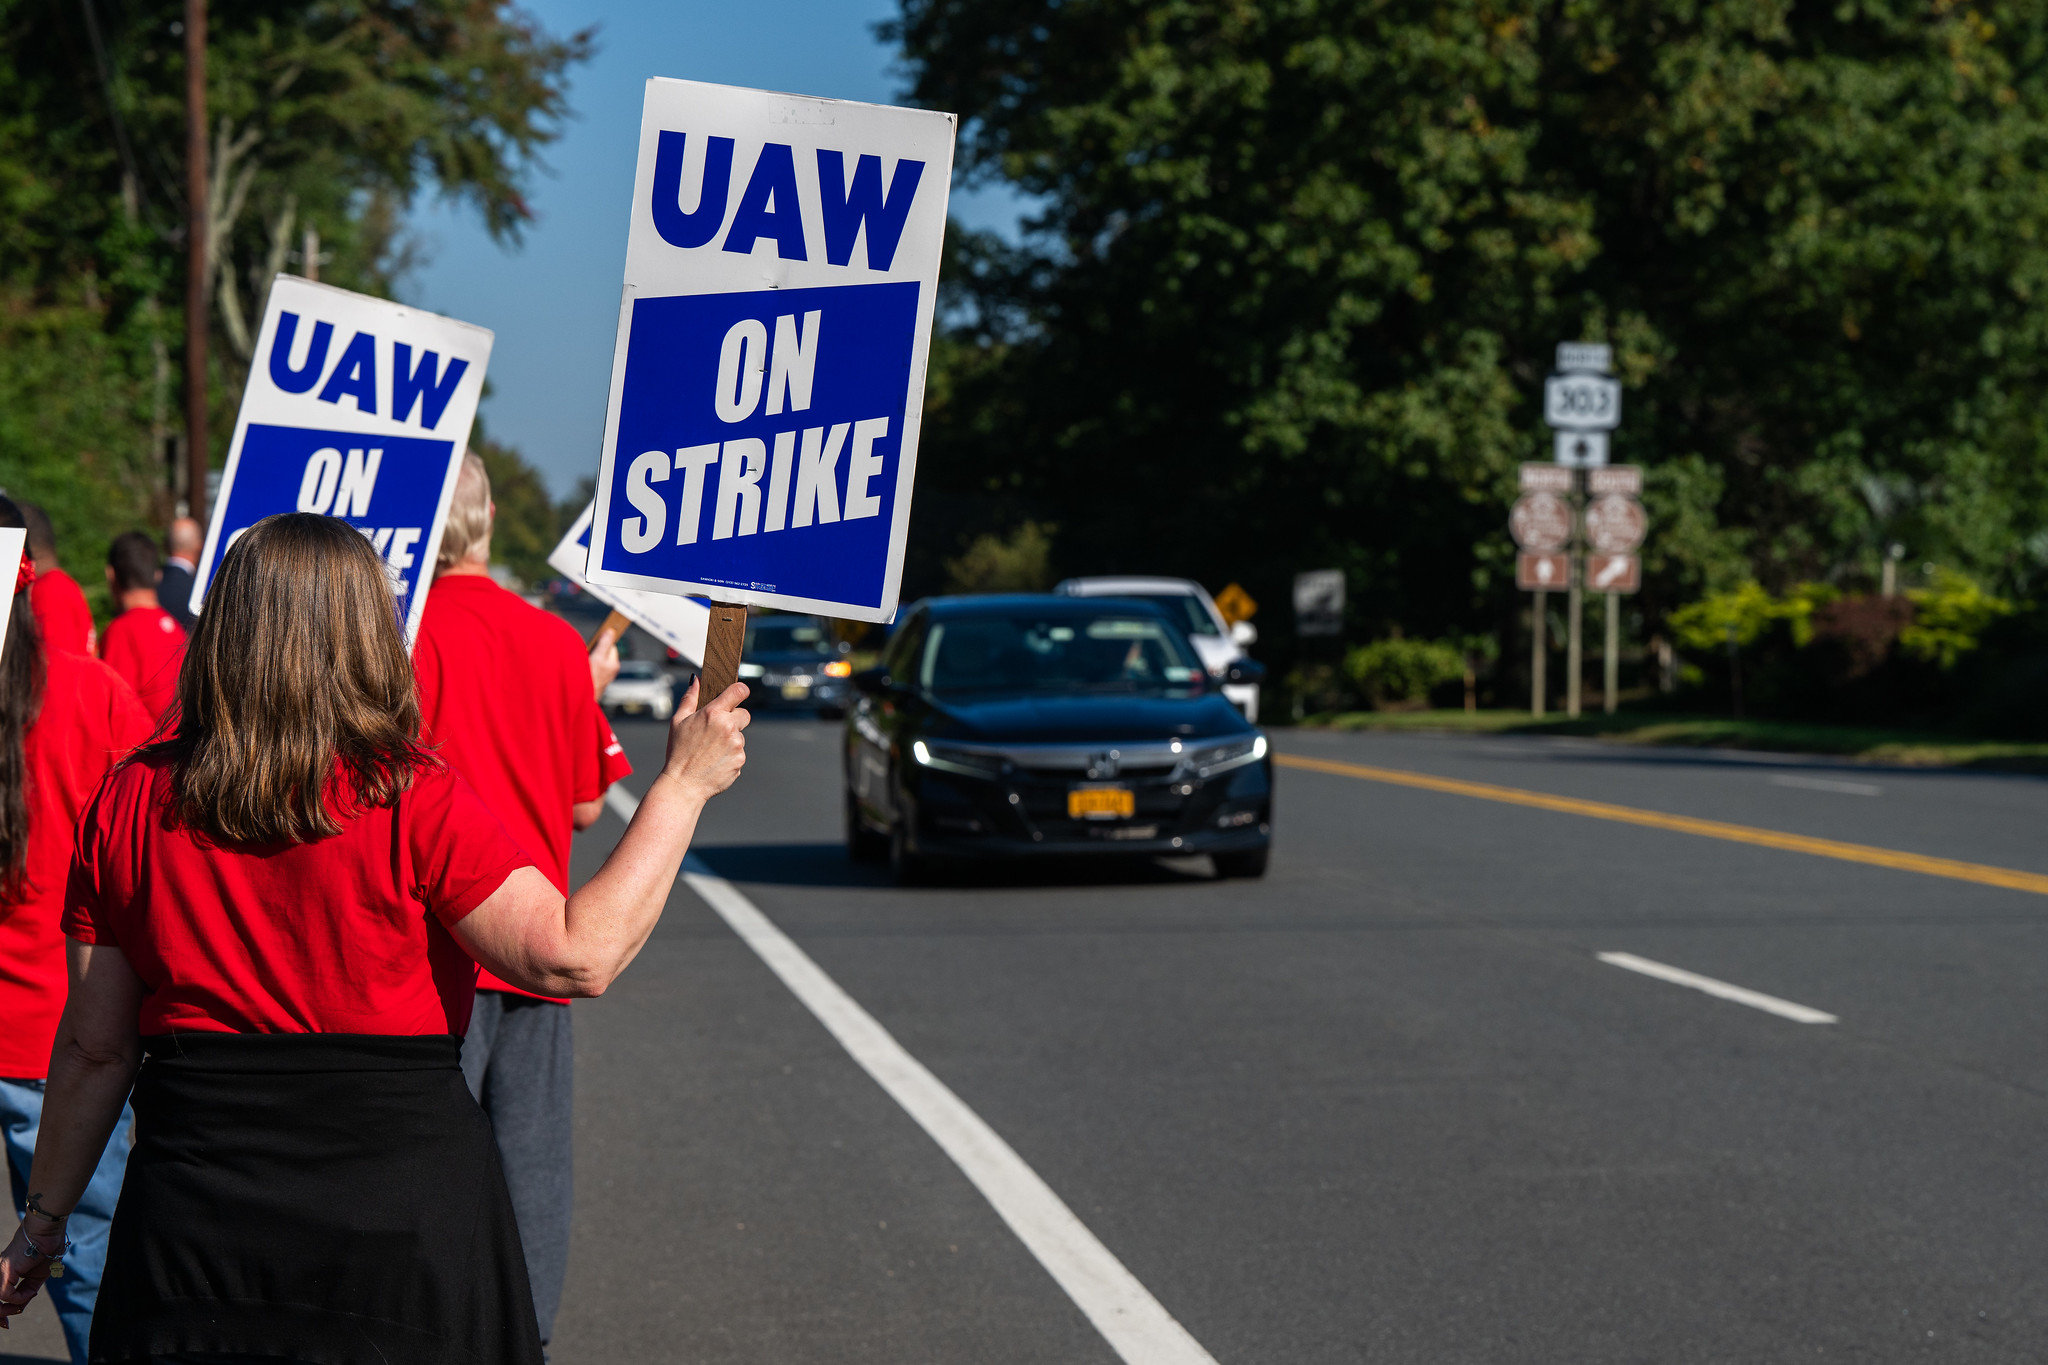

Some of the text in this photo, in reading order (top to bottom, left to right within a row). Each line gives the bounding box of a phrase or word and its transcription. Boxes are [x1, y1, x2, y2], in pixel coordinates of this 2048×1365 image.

[652, 130, 926, 271] UAW
[269, 310, 470, 431] UAW
[715, 310, 821, 423] ON
[297, 447, 384, 518] ON
[620, 417, 889, 554] STRIKE
